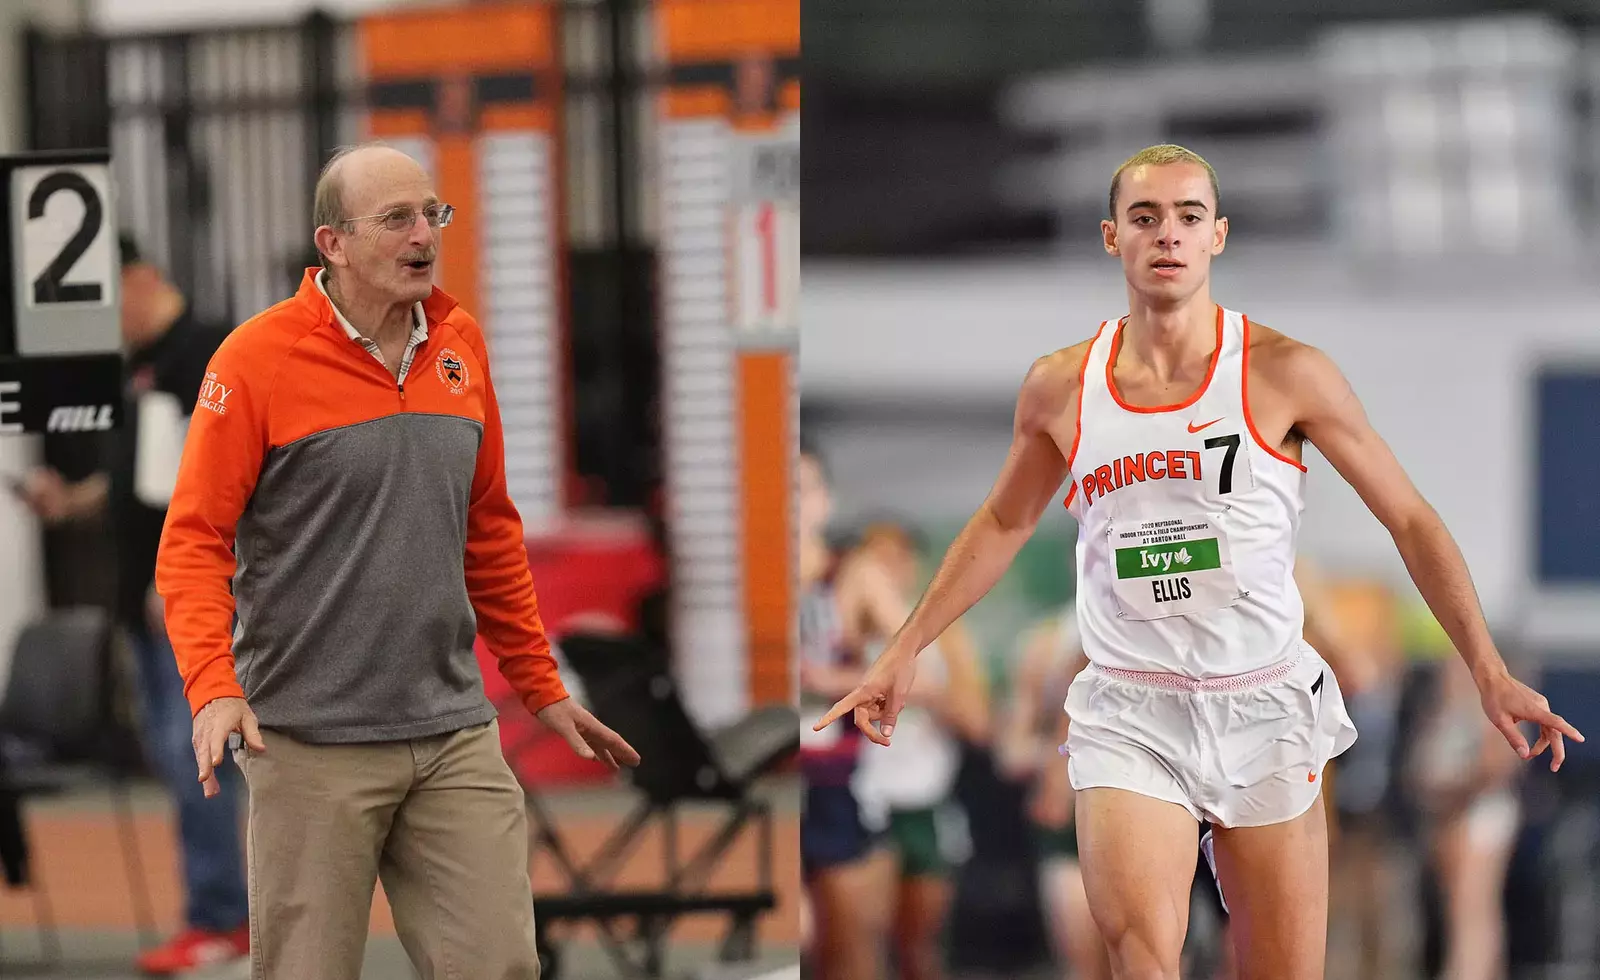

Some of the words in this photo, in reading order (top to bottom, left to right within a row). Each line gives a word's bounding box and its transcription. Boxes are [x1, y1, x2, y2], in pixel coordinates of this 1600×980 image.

[28, 170, 103, 303] 2
[202, 379, 233, 404] IVY
[1204, 433, 1241, 495] 7
[1120, 531, 1136, 539] INDOOR
[1137, 529, 1153, 537] TRACK
[1170, 523, 1208, 533] CHAMPIONSHIPS
[1155, 519, 1183, 528] HEPTAGONAL
[1151, 536, 1172, 544] BARTON
[1173, 533, 1186, 541] HALL
[1140, 550, 1173, 571] Ivy
[1152, 577, 1192, 603] ELLIS
